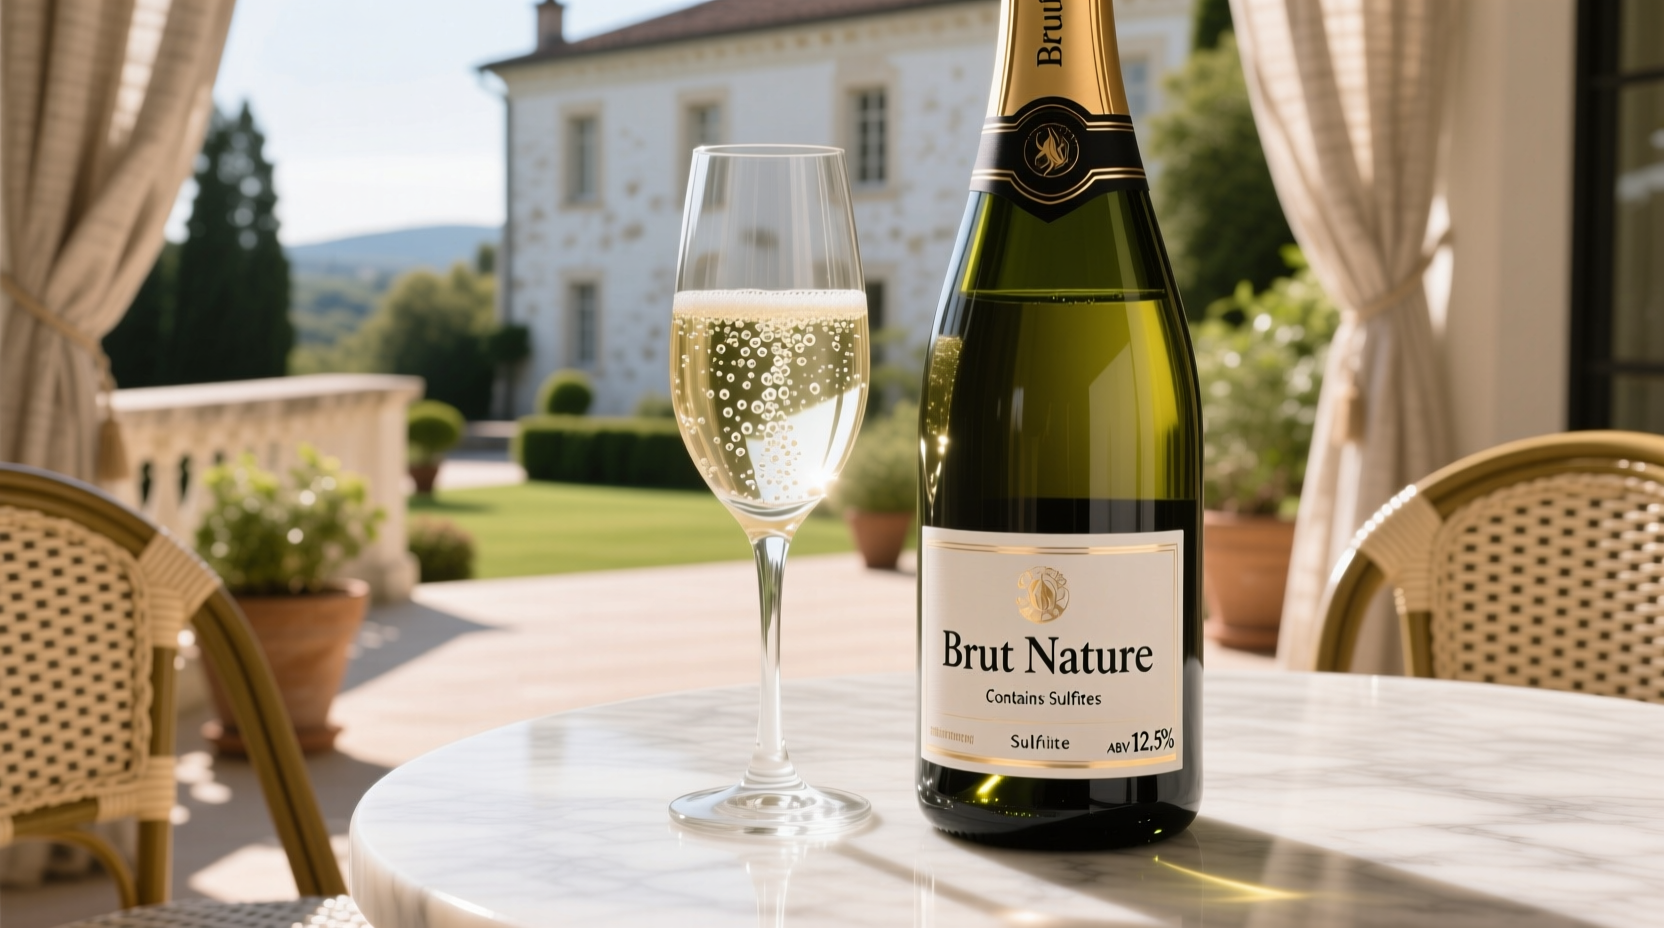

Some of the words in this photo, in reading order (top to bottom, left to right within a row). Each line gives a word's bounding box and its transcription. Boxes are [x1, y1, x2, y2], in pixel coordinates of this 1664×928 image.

[943, 630, 1014, 672] Brut
[1025, 637, 1153, 674] Nature
[986, 689, 1044, 705] Contains
[1050, 691, 1101, 705] Sulfites
[1107, 742, 1130, 753] ABV
[1132, 728, 1174, 752] 12.5%
